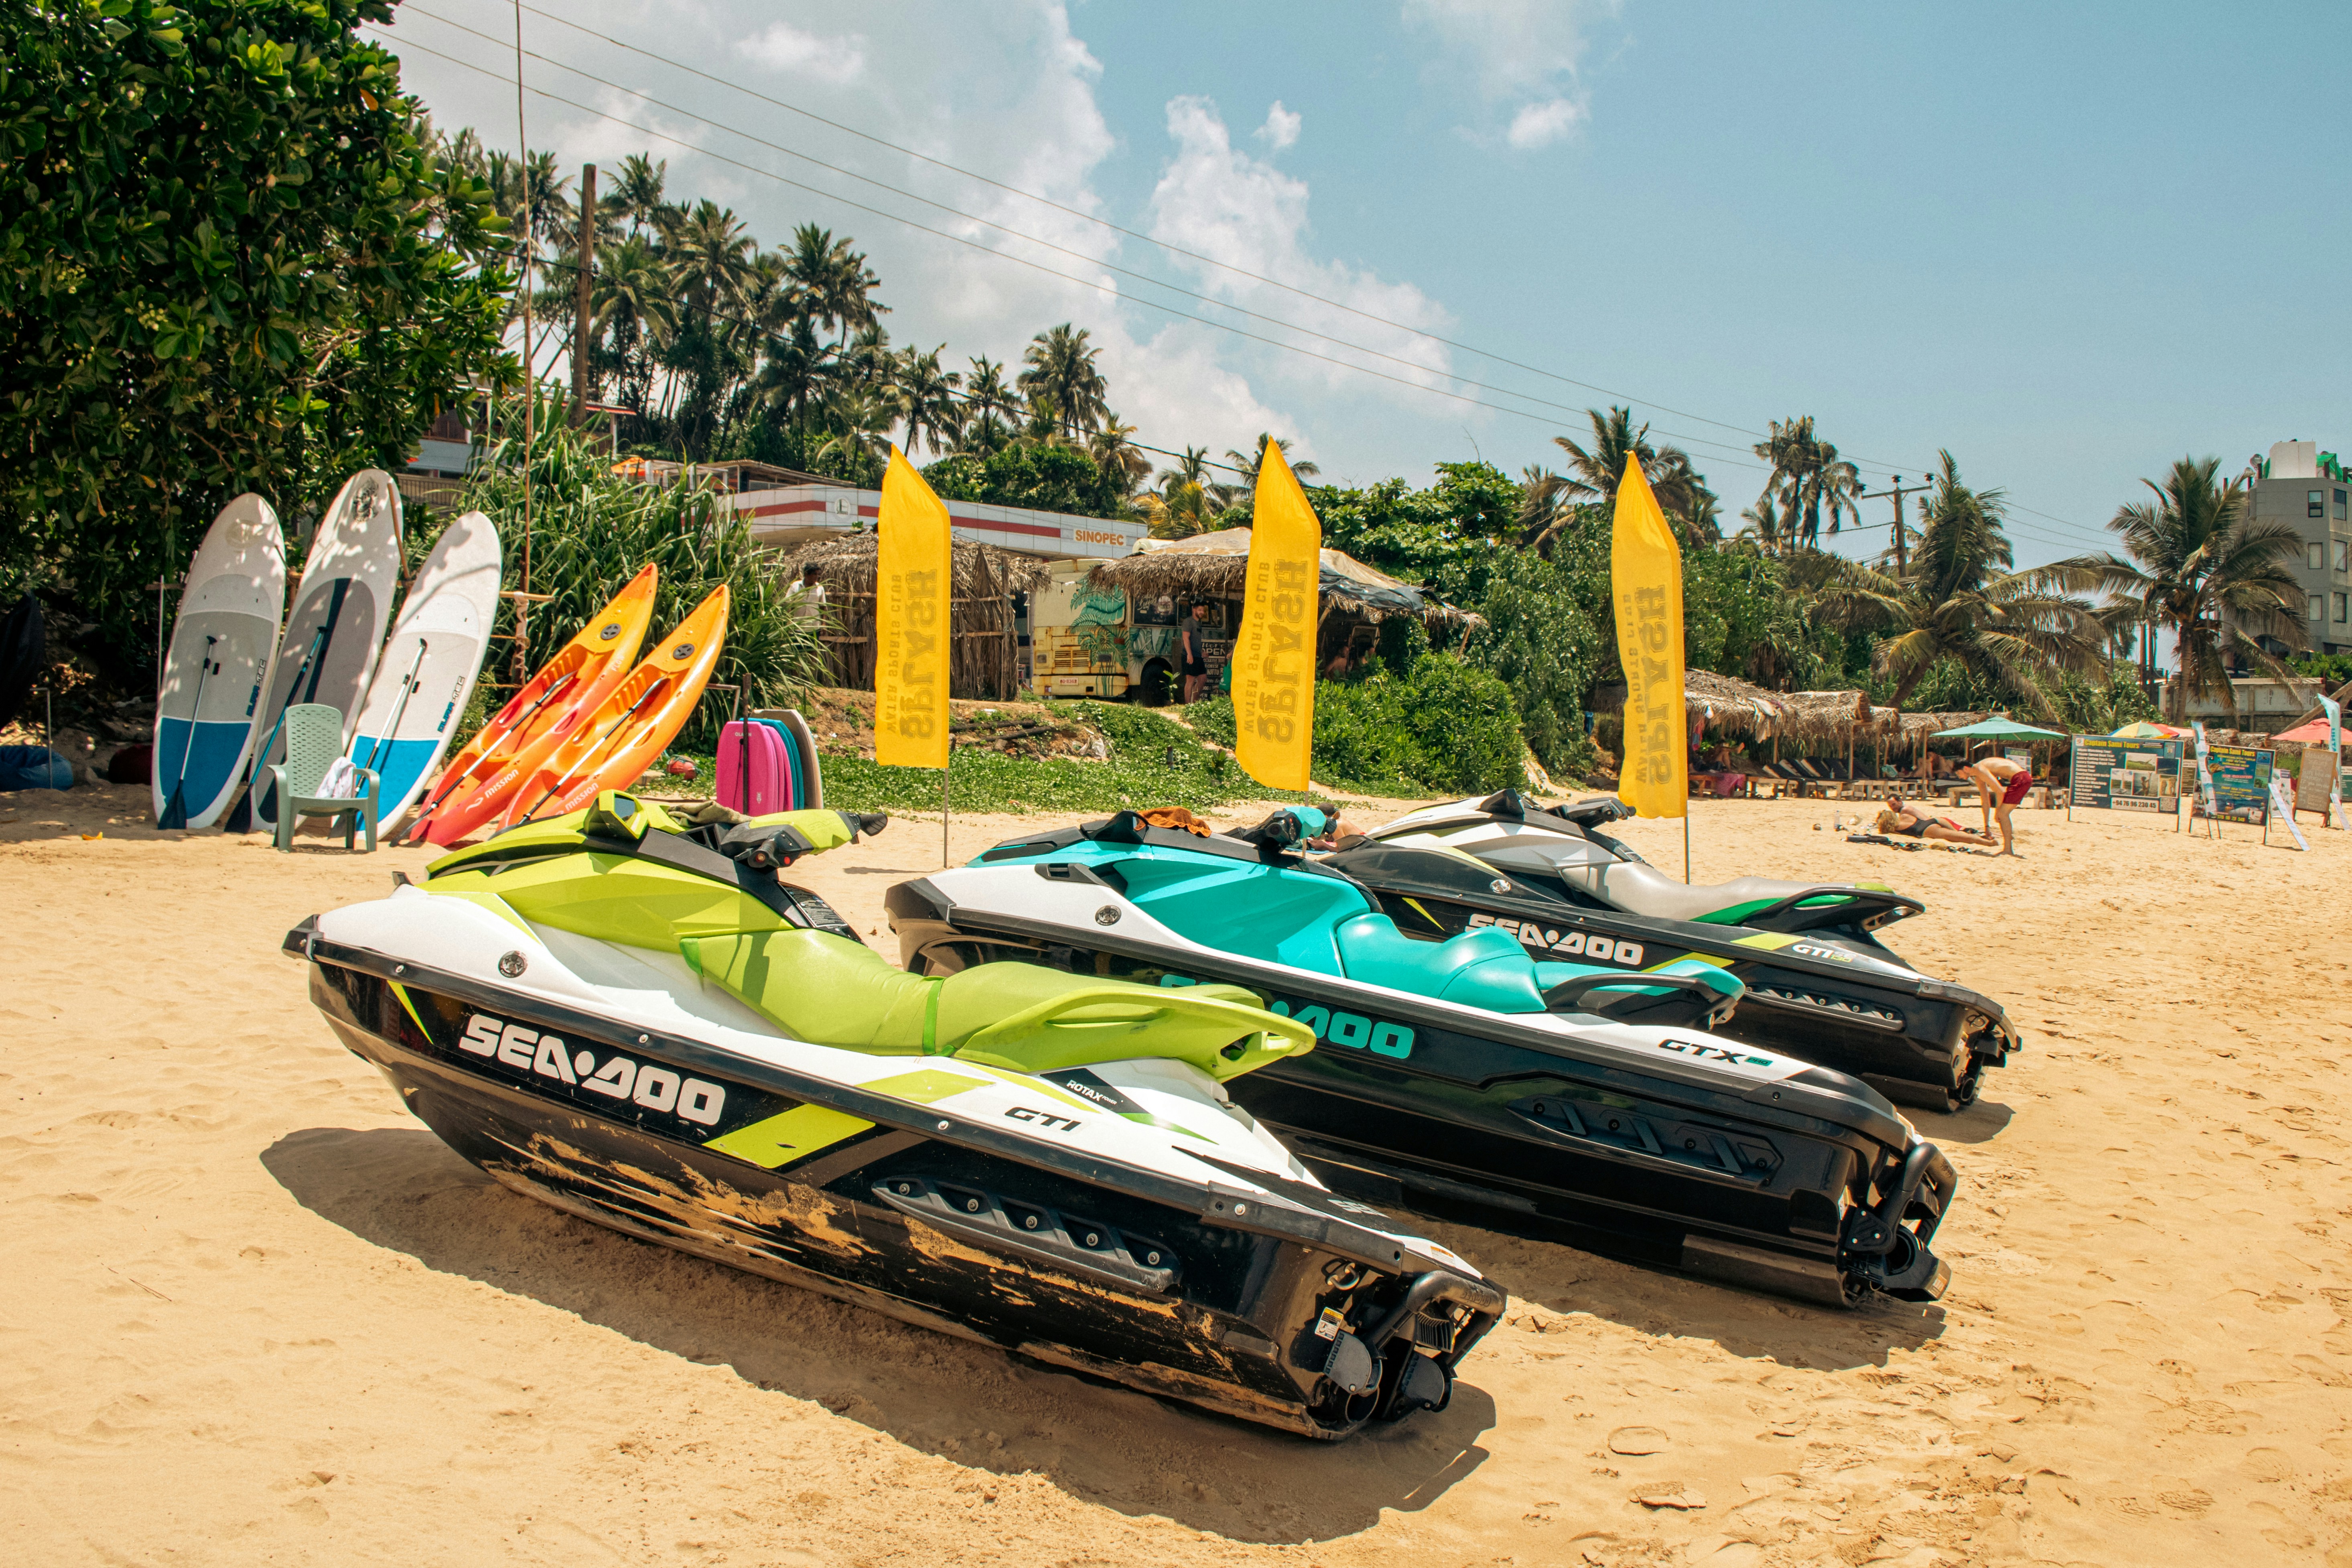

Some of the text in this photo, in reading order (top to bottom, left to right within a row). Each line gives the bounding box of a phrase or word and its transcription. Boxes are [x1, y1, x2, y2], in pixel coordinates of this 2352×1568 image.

[1075, 529, 1124, 546] SINOPEC
[246, 659, 266, 717] DURA-TEC
[437, 675, 465, 732] DURA-TEC
[485, 768, 519, 798] mission
[565, 782, 599, 812] mission
[1792, 944, 1835, 959] GTI
[1658, 1039, 1747, 1065] GTX
[1066, 1079, 1103, 1101] ROTAX
[1102, 1096, 1117, 1105] POWER
[1005, 1107, 1082, 1132] GTI
